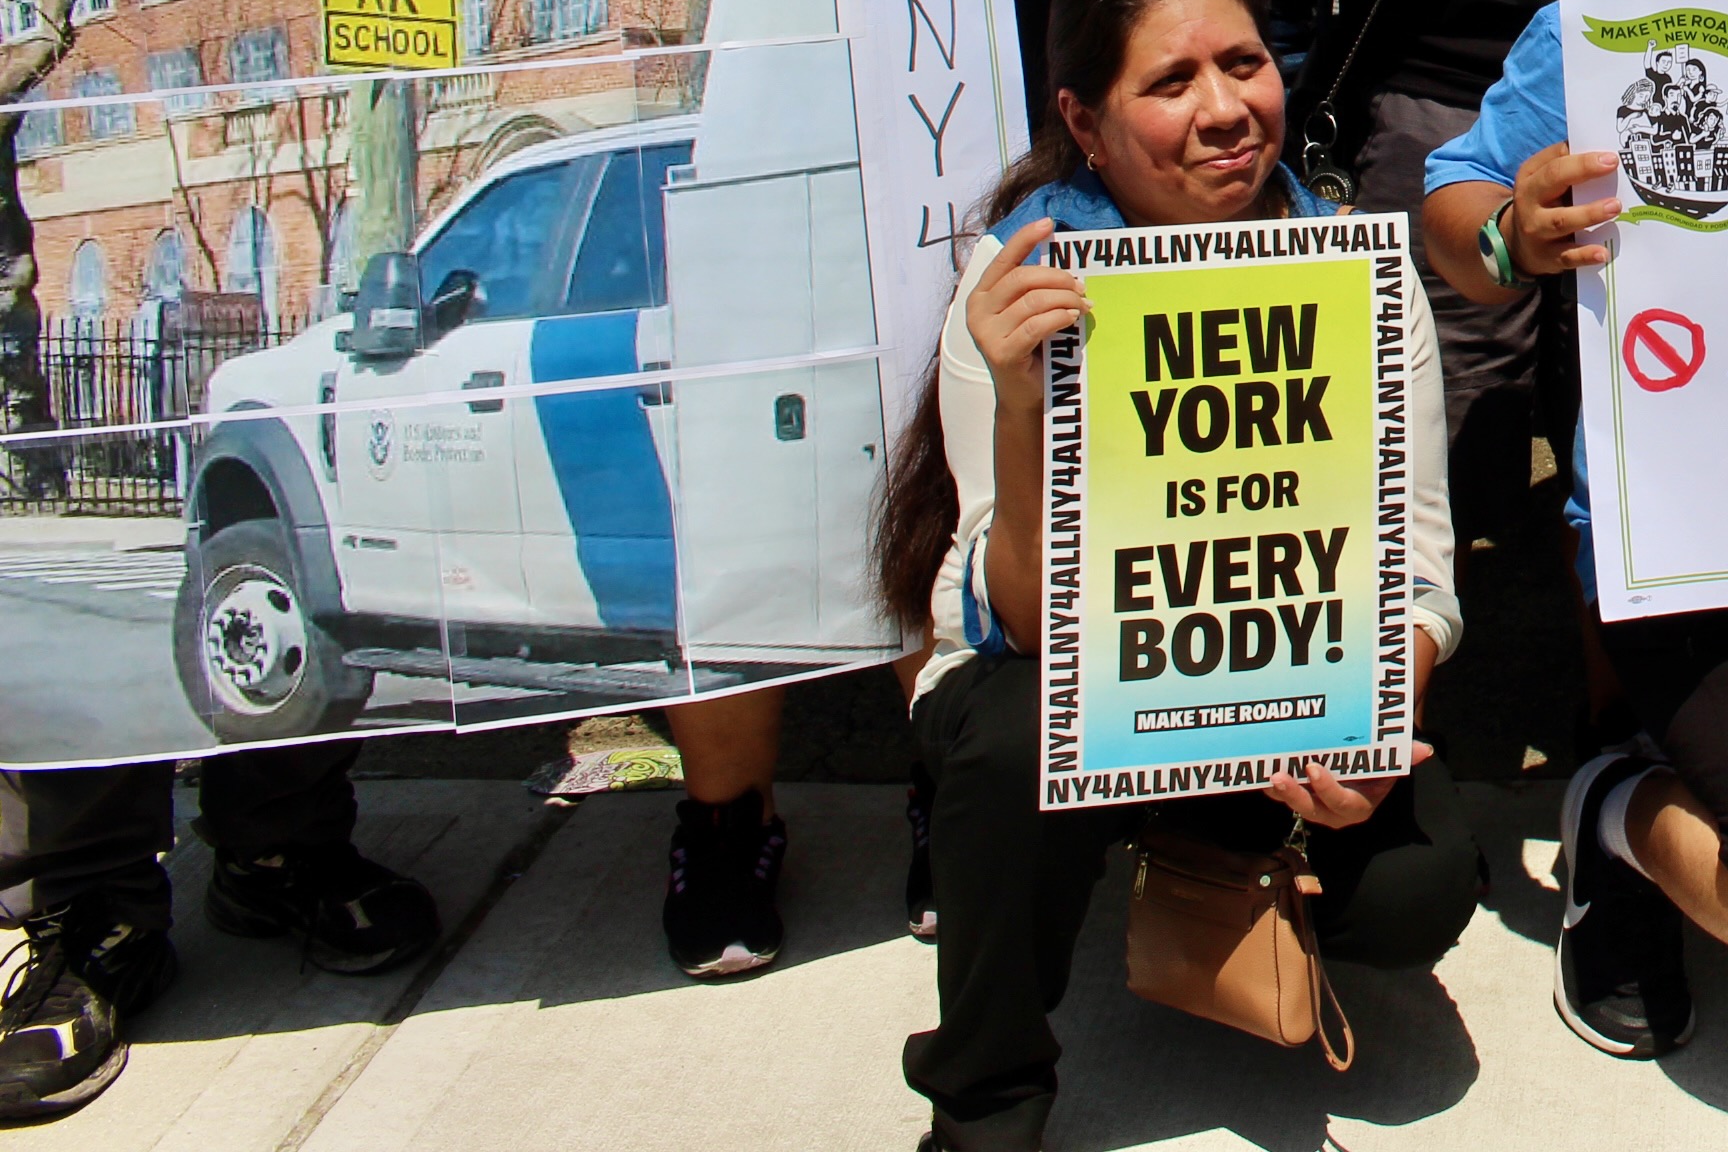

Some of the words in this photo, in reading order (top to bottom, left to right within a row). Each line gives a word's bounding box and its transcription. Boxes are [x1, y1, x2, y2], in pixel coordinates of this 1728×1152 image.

[335, 23, 448, 58] SCHOOL
[1600, 22, 1651, 40] MAKE
[1652, 14, 1687, 32] THE
[1664, 30, 1697, 43] NEW
[1049, 222, 1403, 270] NY4ALLNY4ALLNY4ALL
[1143, 303, 1319, 383] NEW
[1130, 376, 1333, 457] YORK
[1166, 477, 1206, 519] IS
[1216, 470, 1300, 514] FOR
[1375, 255, 1406, 743] NY4ALLNY4ALLNY4ALLNY4ALL
[1113, 526, 1350, 614] EVERY
[1118, 599, 1345, 683] BODY!
[1137, 708, 1196, 731] MAKE
[1199, 704, 1236, 726] THE
[1239, 700, 1294, 722] ROAD
[1296, 697, 1324, 717] NY
